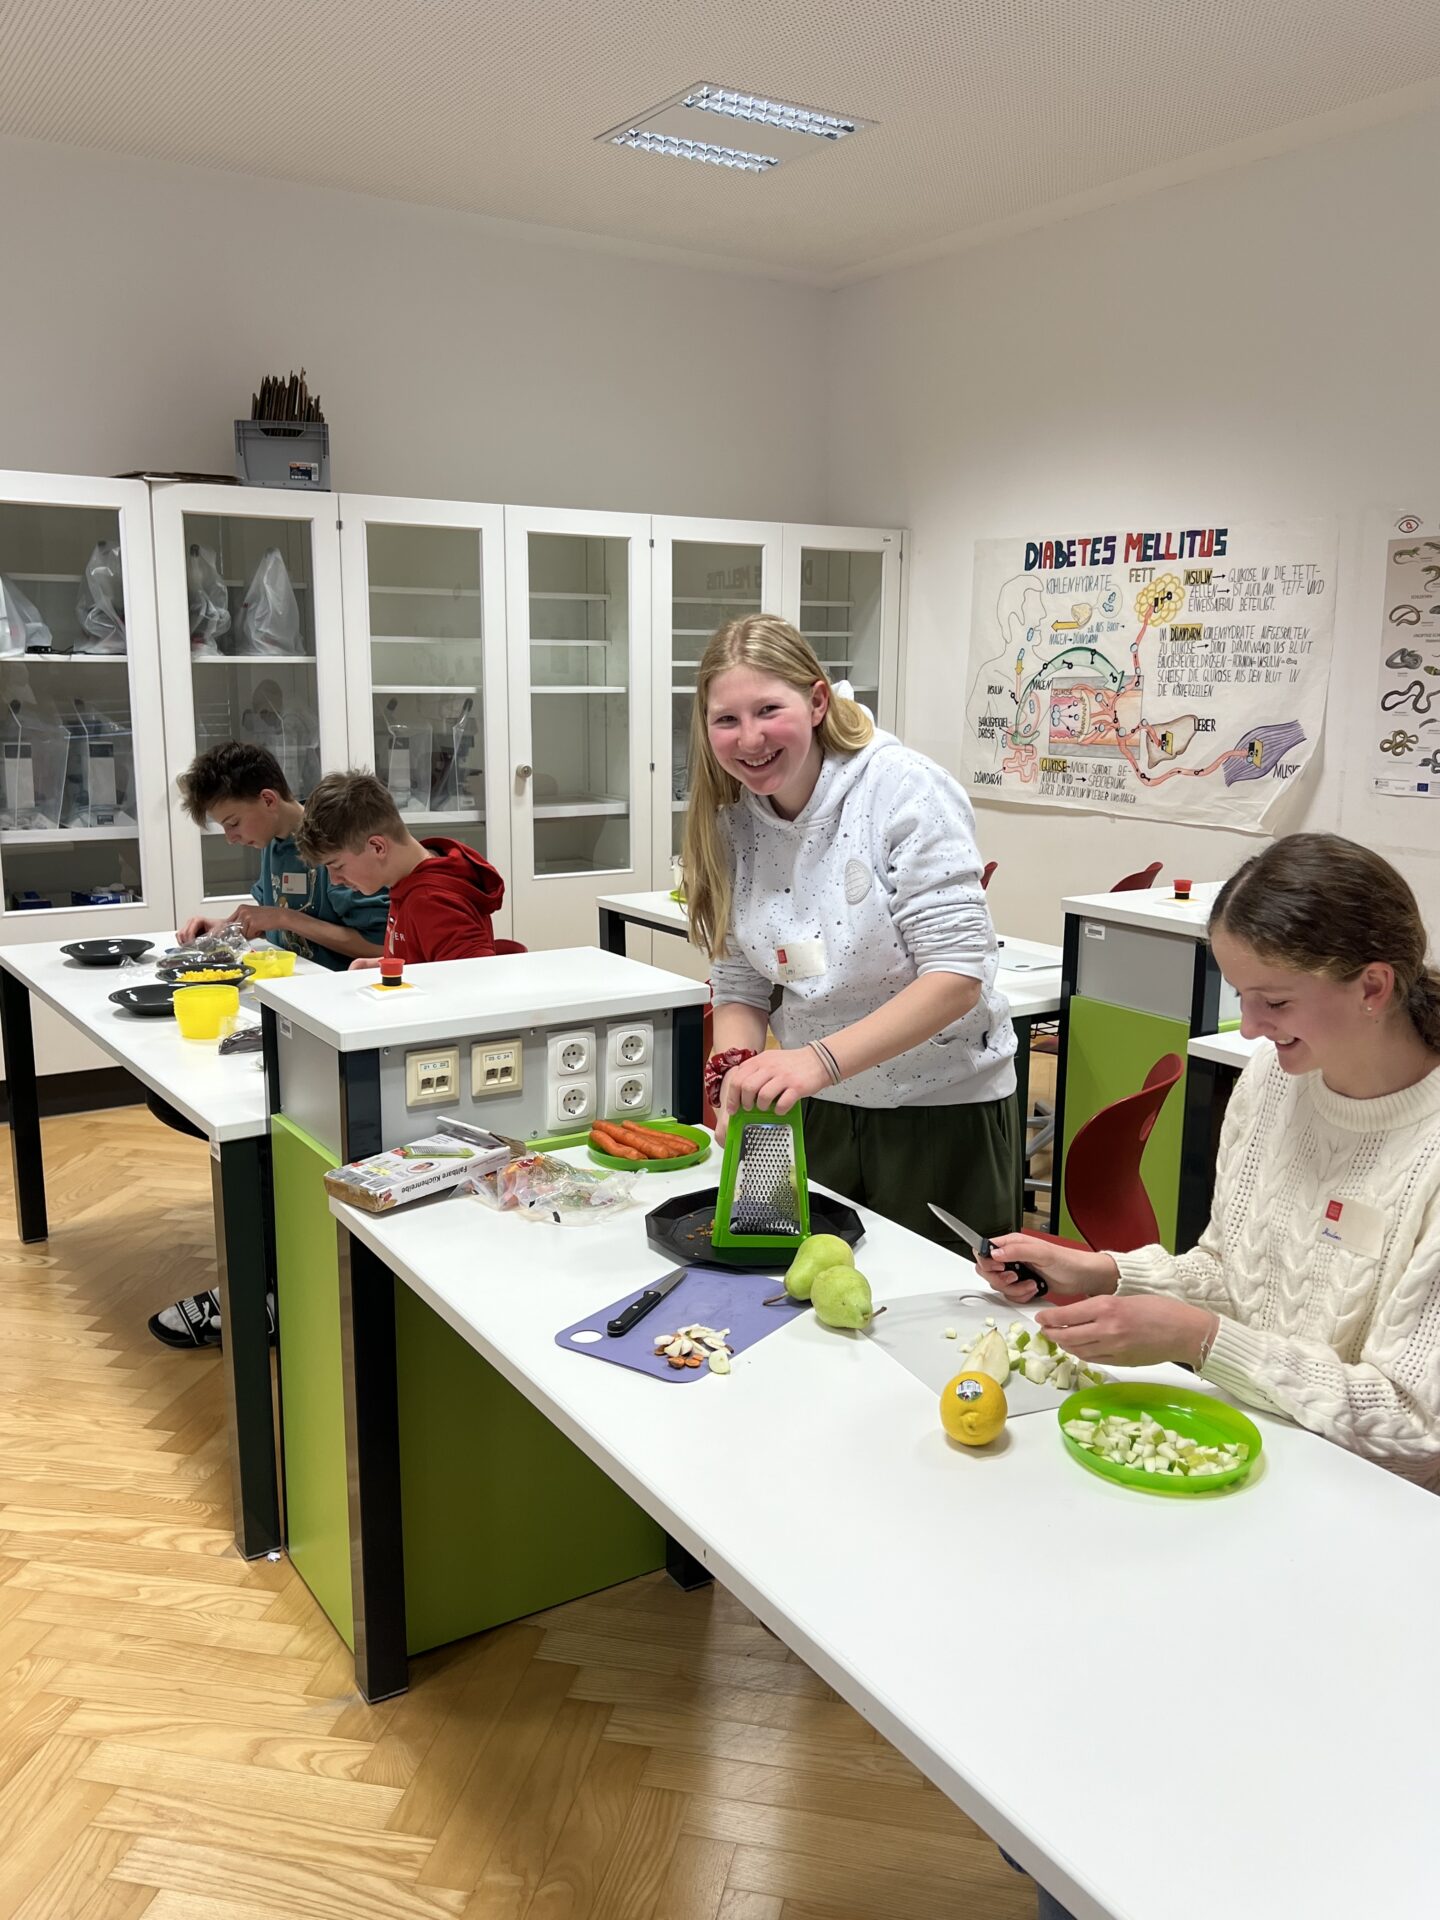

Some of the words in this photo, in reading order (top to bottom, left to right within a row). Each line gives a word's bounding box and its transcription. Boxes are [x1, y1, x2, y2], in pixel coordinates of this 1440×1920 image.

[1024, 535, 1117, 570] DIABETES
[1123, 529, 1228, 563] MELLITUS
[1129, 568, 1156, 583] FETT
[1184, 569, 1213, 585] INSULIN
[1229, 567, 1257, 582] GLUKOSE
[1261, 567, 1271, 581] IN
[1274, 565, 1287, 580] DIE
[1291, 564, 1321, 580] FETT-
[1046, 575, 1112, 594] KOHLENHYDRATE
[1190, 584, 1218, 598] ZELLEN
[1233, 583, 1243, 596] IST
[1262, 582, 1274, 596] AM
[1307, 579, 1325, 595] UND
[1049, 633, 1068, 645] MAGEN
[1170, 626, 1202, 641] DÜNNDARM
[1203, 625, 1256, 640] KOHLENHYDRATE
[1159, 641, 1168, 656] ZU
[1170, 641, 1196, 655] GLUKOSE
[1231, 640, 1270, 655] DARMWAND
[1273, 641, 1285, 654] INS
[1287, 641, 1314, 654] BLUT
[1188, 669, 1199, 682] DIE
[1203, 669, 1232, 683] GLUKOSE
[1234, 669, 1246, 683] AUS
[1265, 669, 1282, 683] BLUT
[1289, 669, 1301, 683] IN
[987, 685, 1004, 695] INSULIN
[1031, 679, 1052, 691] MAGEN
[1157, 683, 1168, 697] DIE
[1193, 719, 1216, 731] LEBER
[441, 1166, 468, 1182] Faltbare
[401, 1175, 442, 1194] Küchenreibe
[182, 1297, 203, 1324] PUMA
